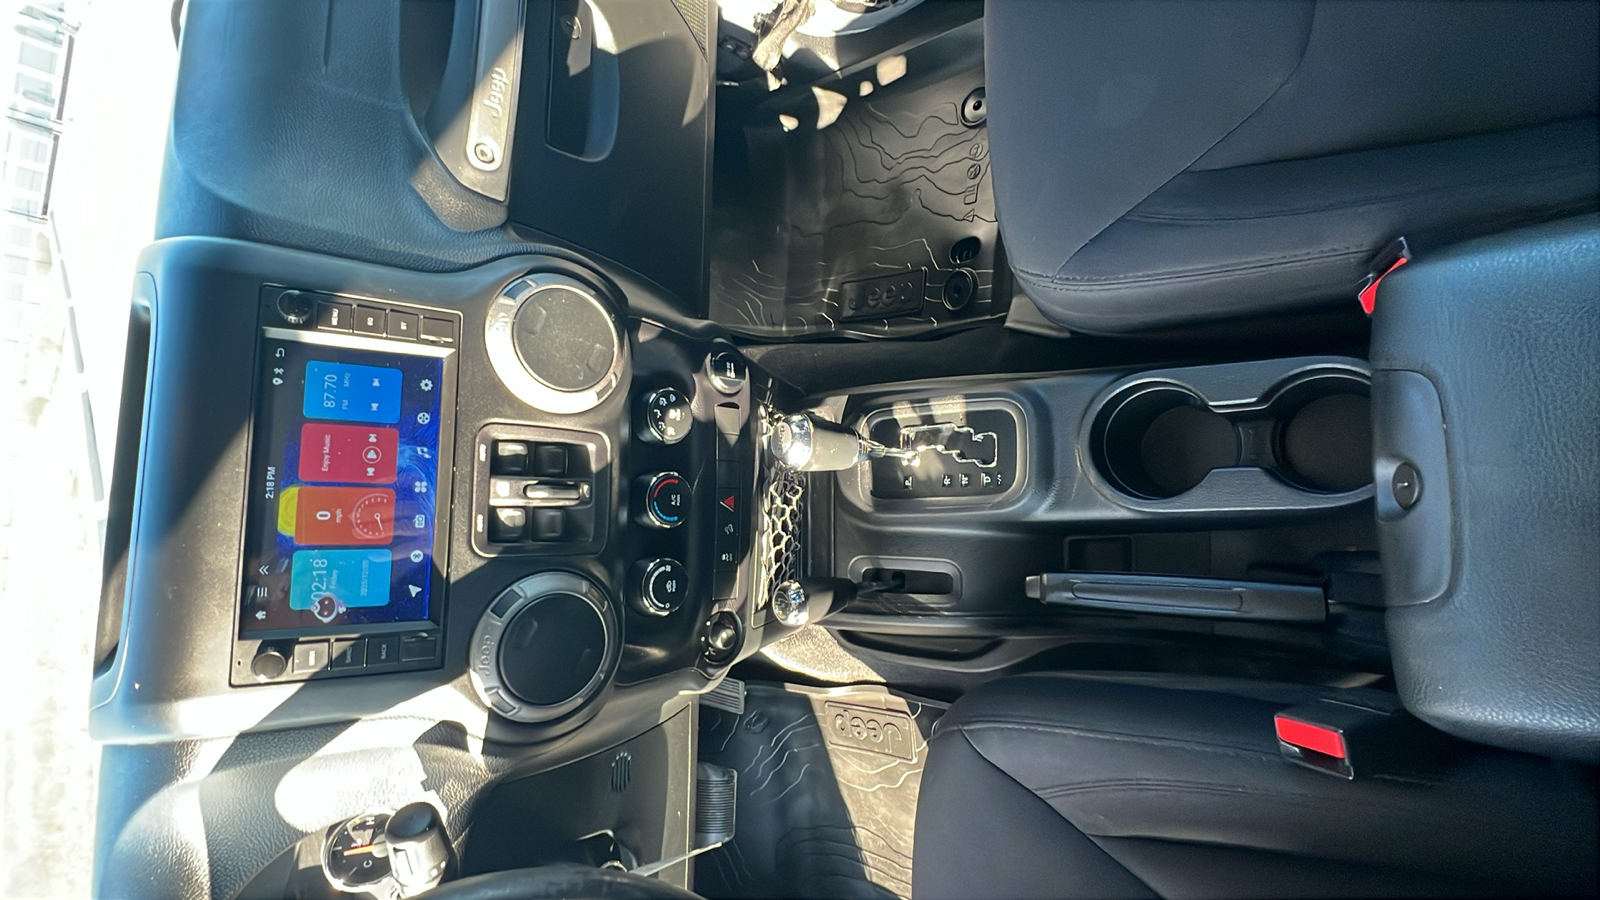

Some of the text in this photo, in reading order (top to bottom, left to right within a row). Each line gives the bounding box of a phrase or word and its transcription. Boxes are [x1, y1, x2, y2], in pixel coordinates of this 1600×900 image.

[483, 67, 509, 119] Jeep
[850, 281, 914, 311] Jeep
[331, 308, 339, 326] MENU
[323, 374, 338, 409] 87.70
[342, 399, 349, 410] FM
[321, 434, 331, 472] Enjoy Music
[265, 466, 276, 499] 2:18 PM
[944, 477, 950, 485] R
[316, 510, 331, 521] 0
[334, 508, 343, 523] mph
[479, 633, 494, 678] Jeep
[835, 708, 901, 751] Jeep
[366, 816, 375, 825] H
[363, 859, 372, 868] C
